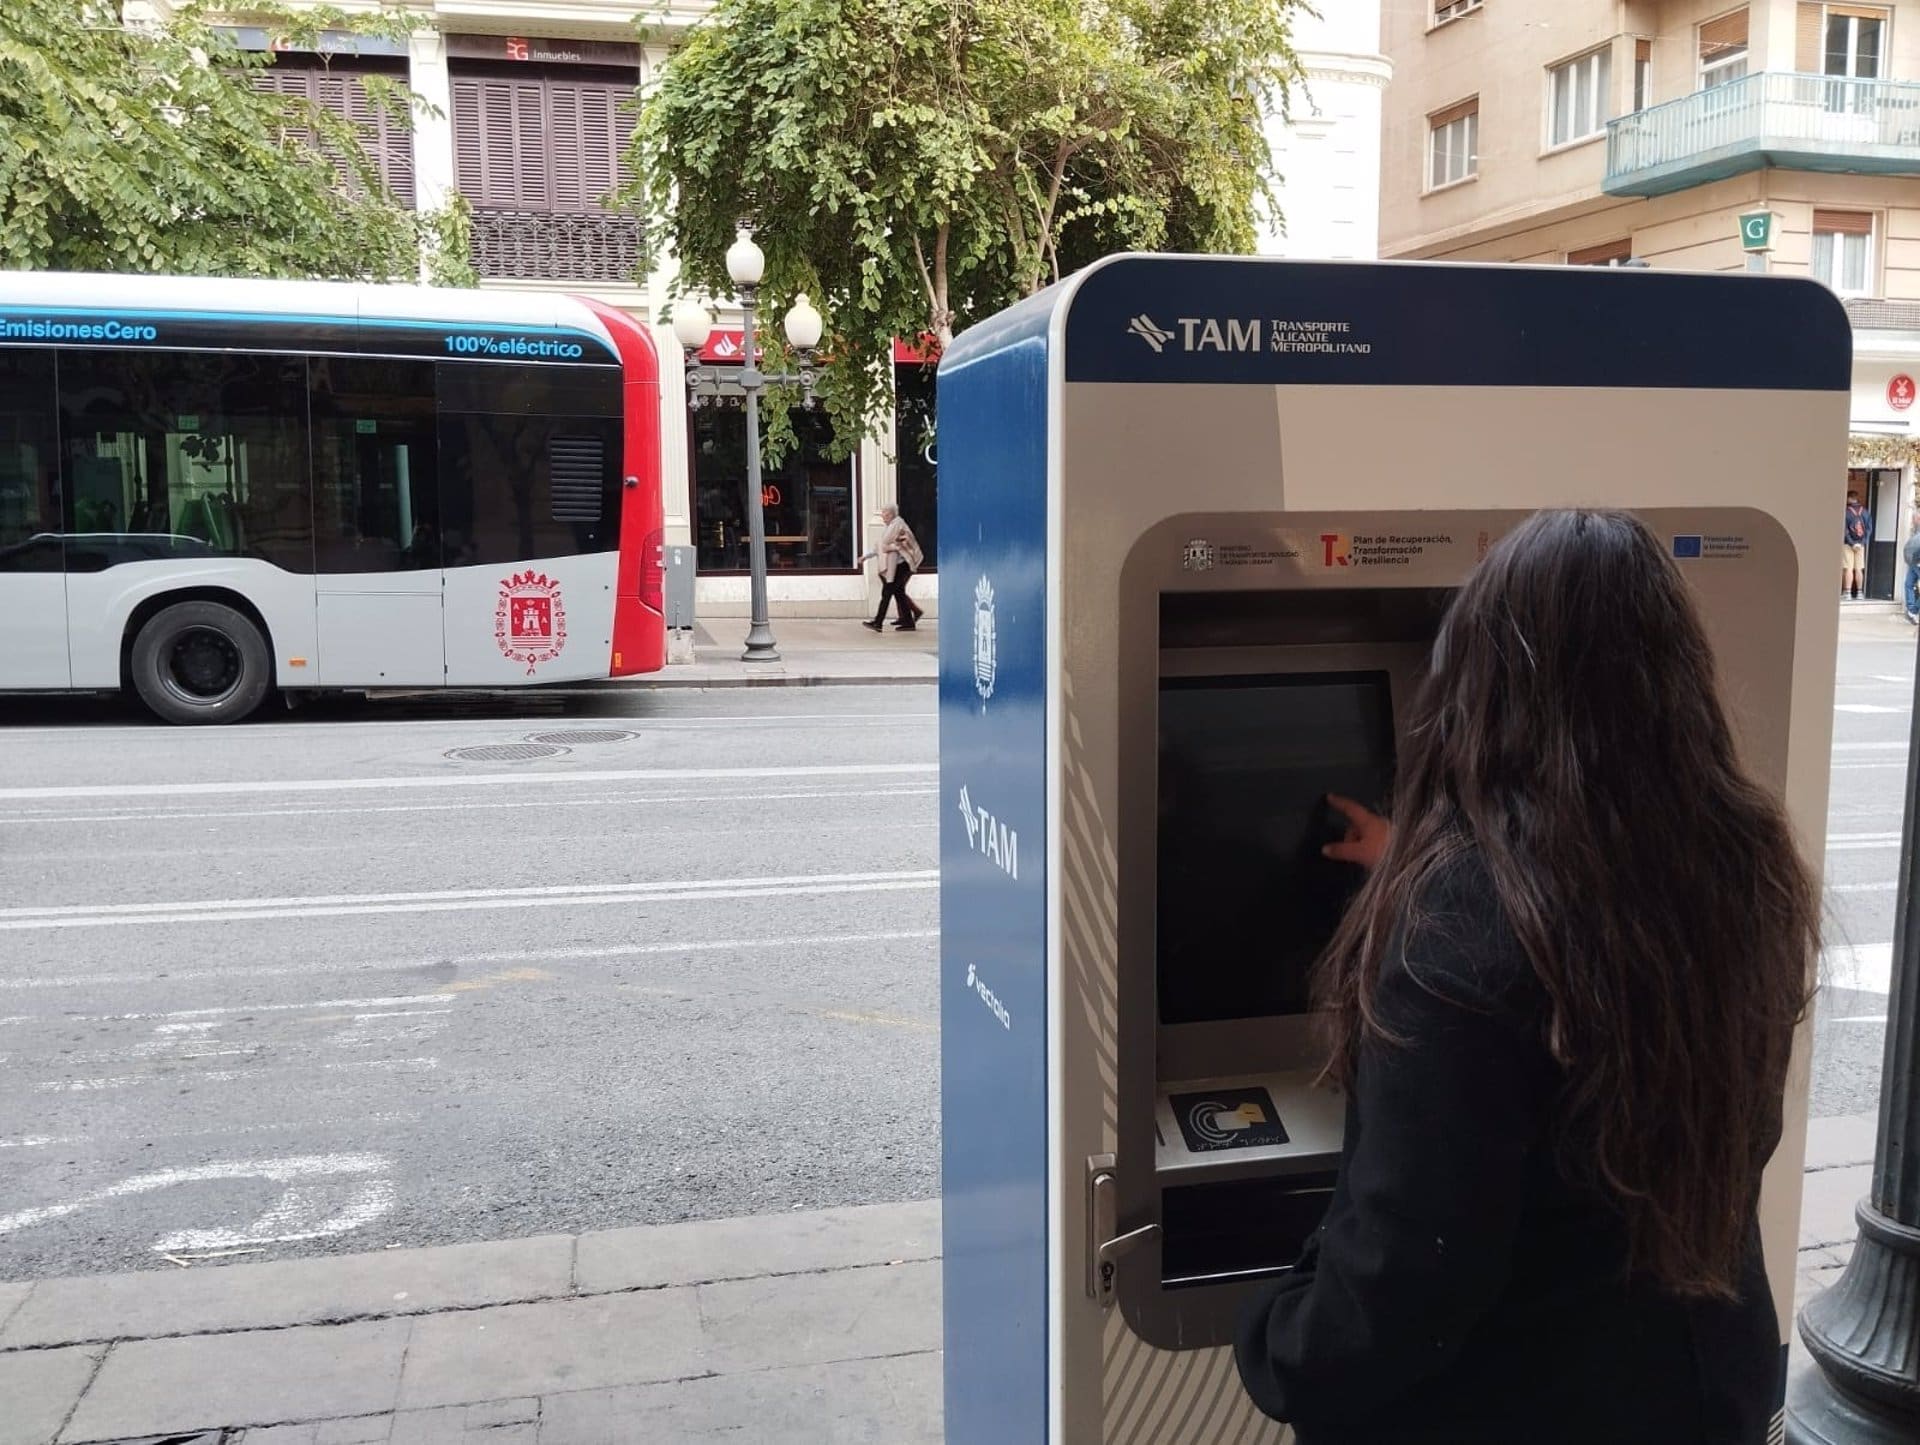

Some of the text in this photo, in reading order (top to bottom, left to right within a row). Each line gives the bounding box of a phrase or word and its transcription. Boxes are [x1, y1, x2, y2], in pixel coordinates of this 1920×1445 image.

[533, 49, 582, 61] Inmuebles
[1746, 218, 1764, 239] G
[1271, 319, 1350, 332] TRANSPORTE
[1178, 318, 1261, 352] TAM
[1271, 331, 1329, 342] ALICANTE
[445, 335, 583, 358] 100%eléctrico
[1271, 341, 1371, 354] METROPOLITANO
[1353, 536, 1373, 544] Plan
[1375, 536, 1387, 544] de
[1353, 546, 1423, 555] Transformación
[1353, 556, 1410, 566] y Resiliencia
[977, 805, 1018, 881] TAM
